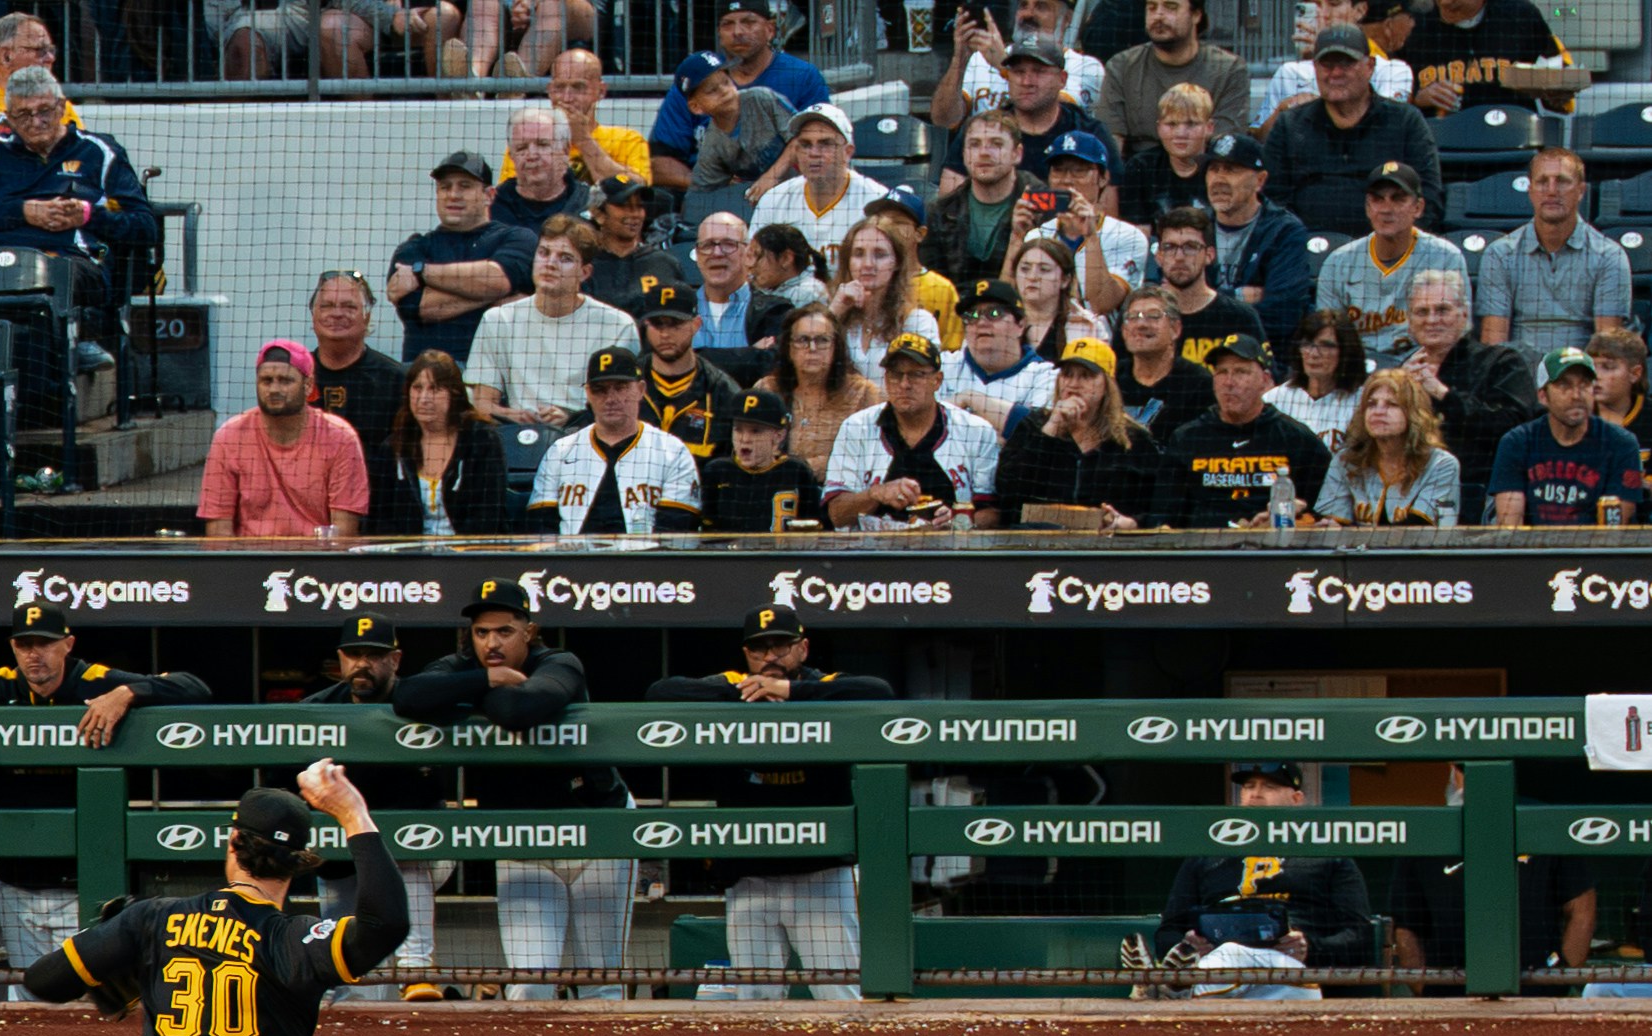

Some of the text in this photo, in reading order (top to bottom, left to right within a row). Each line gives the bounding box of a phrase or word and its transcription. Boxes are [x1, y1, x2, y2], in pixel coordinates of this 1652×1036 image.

[640, 275, 658, 293] P
[975, 281, 988, 296] P
[661, 287, 675, 304] P
[155, 319, 184, 338] 20
[1074, 342, 1087, 354] P
[600, 353, 612, 371] P
[744, 395, 758, 412] P
[1192, 455, 1290, 473] PIRATES
[1203, 471, 1258, 488] BASEBALL
[1544, 484, 1577, 504] USA
[43, 575, 189, 610] Cygames
[294, 576, 441, 611] Cygames
[481, 580, 497, 599] P
[546, 576, 695, 612] Cygames
[800, 576, 951, 612] Cygames
[1058, 576, 1210, 612] Cygames
[1318, 576, 1473, 612] Cygames
[1582, 575, 1652, 611] Cyg
[26, 606, 42, 625] P
[358, 617, 373, 636] P
[759, 609, 774, 629] P
[213, 724, 346, 747] HYUNDAI
[695, 721, 831, 745] HYUNDAI
[939, 719, 1077, 743] HYUNDAI
[1186, 718, 1324, 742] HYUNDAI
[1435, 717, 1575, 741] HYUNDAI
[452, 825, 586, 847] HYUNDAI
[691, 822, 826, 845] HYUNDAI
[1023, 821, 1161, 843] HYUNDAI
[1268, 821, 1406, 844] HYUNDAI
[165, 912, 261, 962] SKENES
